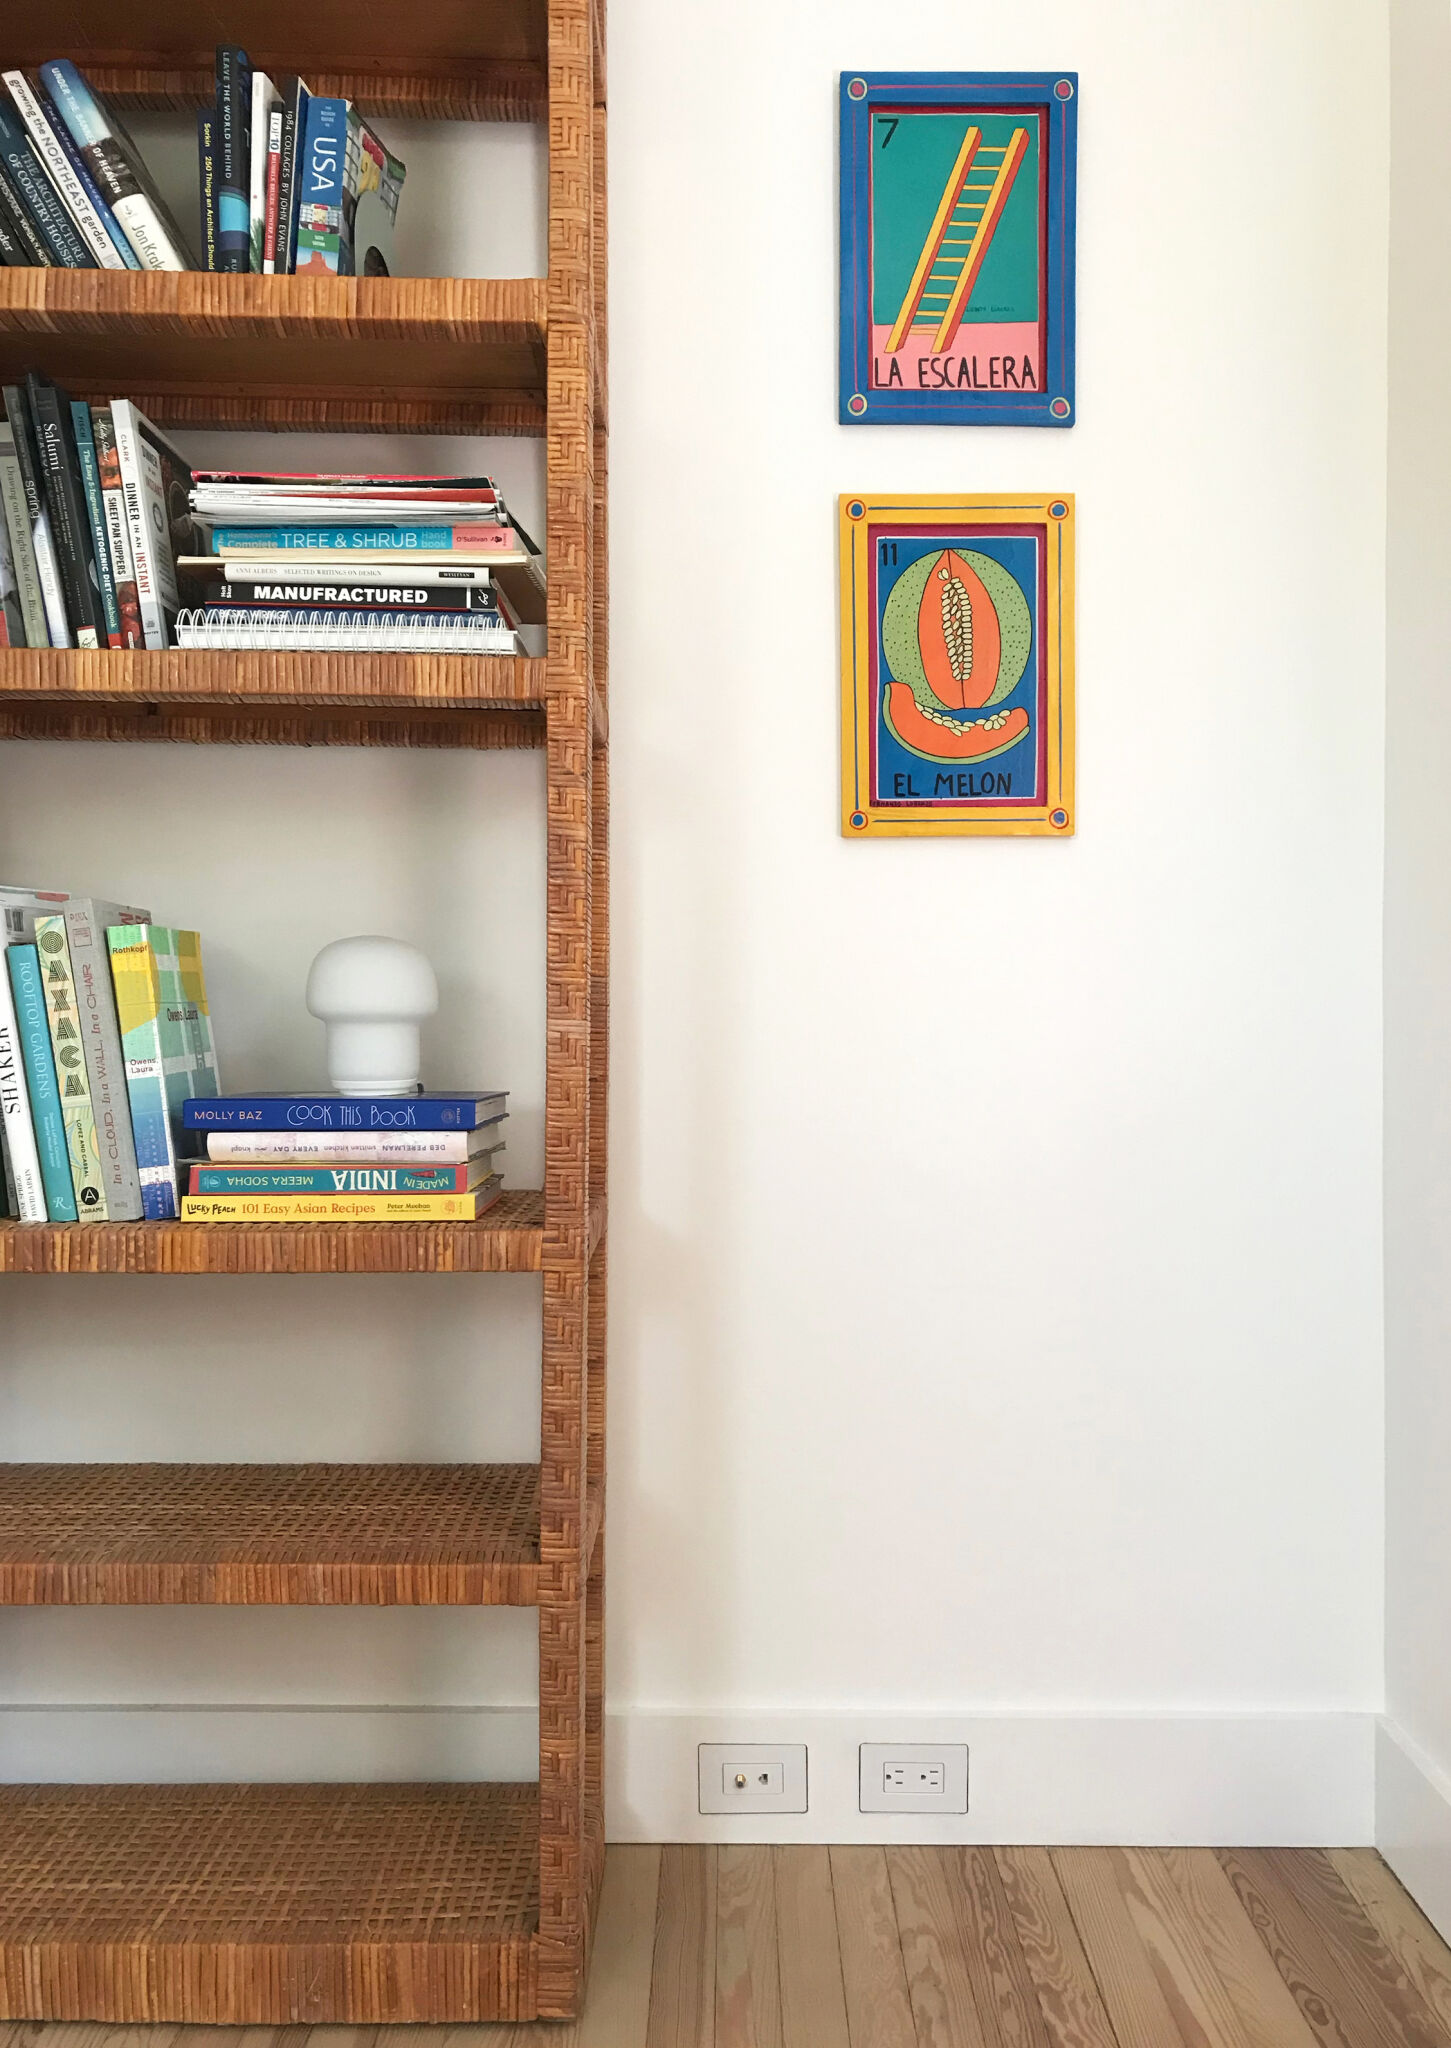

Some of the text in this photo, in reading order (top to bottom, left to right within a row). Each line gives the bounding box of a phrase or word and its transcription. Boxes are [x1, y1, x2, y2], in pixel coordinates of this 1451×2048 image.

[222, 52, 232, 179] LEAVE THE WORLD BEHIND
[51, 67, 71, 95] UNDER
[66, 95, 80, 113] THE
[92, 146, 104, 158] OF
[98, 159, 122, 194] HEAVEN
[204, 123, 212, 147] Sorkin
[877, 118, 899, 149] 7
[270, 138, 280, 150] 10
[8, 79, 107, 249] growing the NORTHEAST garden
[205, 156, 213, 171] 250
[311, 137, 337, 191] USA
[205, 172, 213, 197] Things
[277, 111, 294, 252] 1984 COLLAGES BY JOHN EVANS
[8, 153, 23, 170] OF
[17, 170, 52, 223] COUNTRY
[46, 224, 78, 268] HOUSES
[21, 151, 86, 262] THE ARCHITECTURE
[206, 198, 212, 208] an
[131, 224, 150, 246] Jon
[206, 208, 215, 243] Architect
[874, 355, 1037, 389] LA ESCALERA
[77, 416, 86, 438] FISCH
[43, 423, 64, 470] Salumi
[120, 433, 130, 463] CLARK
[6, 465, 18, 501] Drawing
[12, 501, 19, 513] on
[24, 480, 40, 519] spring
[13, 514, 22, 528] the
[16, 529, 26, 552] Right
[83, 449, 117, 628] The Easy 5-Ingredient KETOGENIC DIET Cookbook
[107, 497, 126, 576] SHEET PAN SUPPERS
[125, 482, 151, 594] DINNER IN AN INSTANT
[227, 540, 278, 548] Complete
[281, 532, 417, 548] TREE & SHRUB
[421, 531, 447, 539] Hand
[421, 540, 447, 548] book
[20, 552, 30, 572] Side
[881, 543, 898, 566] 11
[24, 573, 31, 582] of
[254, 585, 428, 604] MANUFRACTURED
[27, 598, 37, 621] Brain
[893, 772, 1012, 798] EL MELON
[112, 945, 148, 954] Rothkopf
[82, 963, 97, 1010] CHAIR
[19, 962, 40, 1028] ROOFTOP
[30, 1033, 52, 1099] GARDENS
[91, 1022, 100, 1035] In
[130, 1058, 159, 1074] Owens, Laura
[102, 1092, 111, 1104] In
[194, 1111, 263, 1120] MOLLY BAZ
[286, 1105, 333, 1126] COOK
[370, 1105, 416, 1126] BOOK
[113, 1174, 122, 1185] In
[227, 1176, 314, 1186] MEERA SODHA
[331, 1170, 397, 1191] INDIA
[403, 1176, 450, 1190] MADE IN
[25, 1168, 37, 1217] DAVID LARKIN
[212, 1204, 236, 1215] PEACH
[242, 1203, 376, 1216] 101 Easy Asian Recipes
